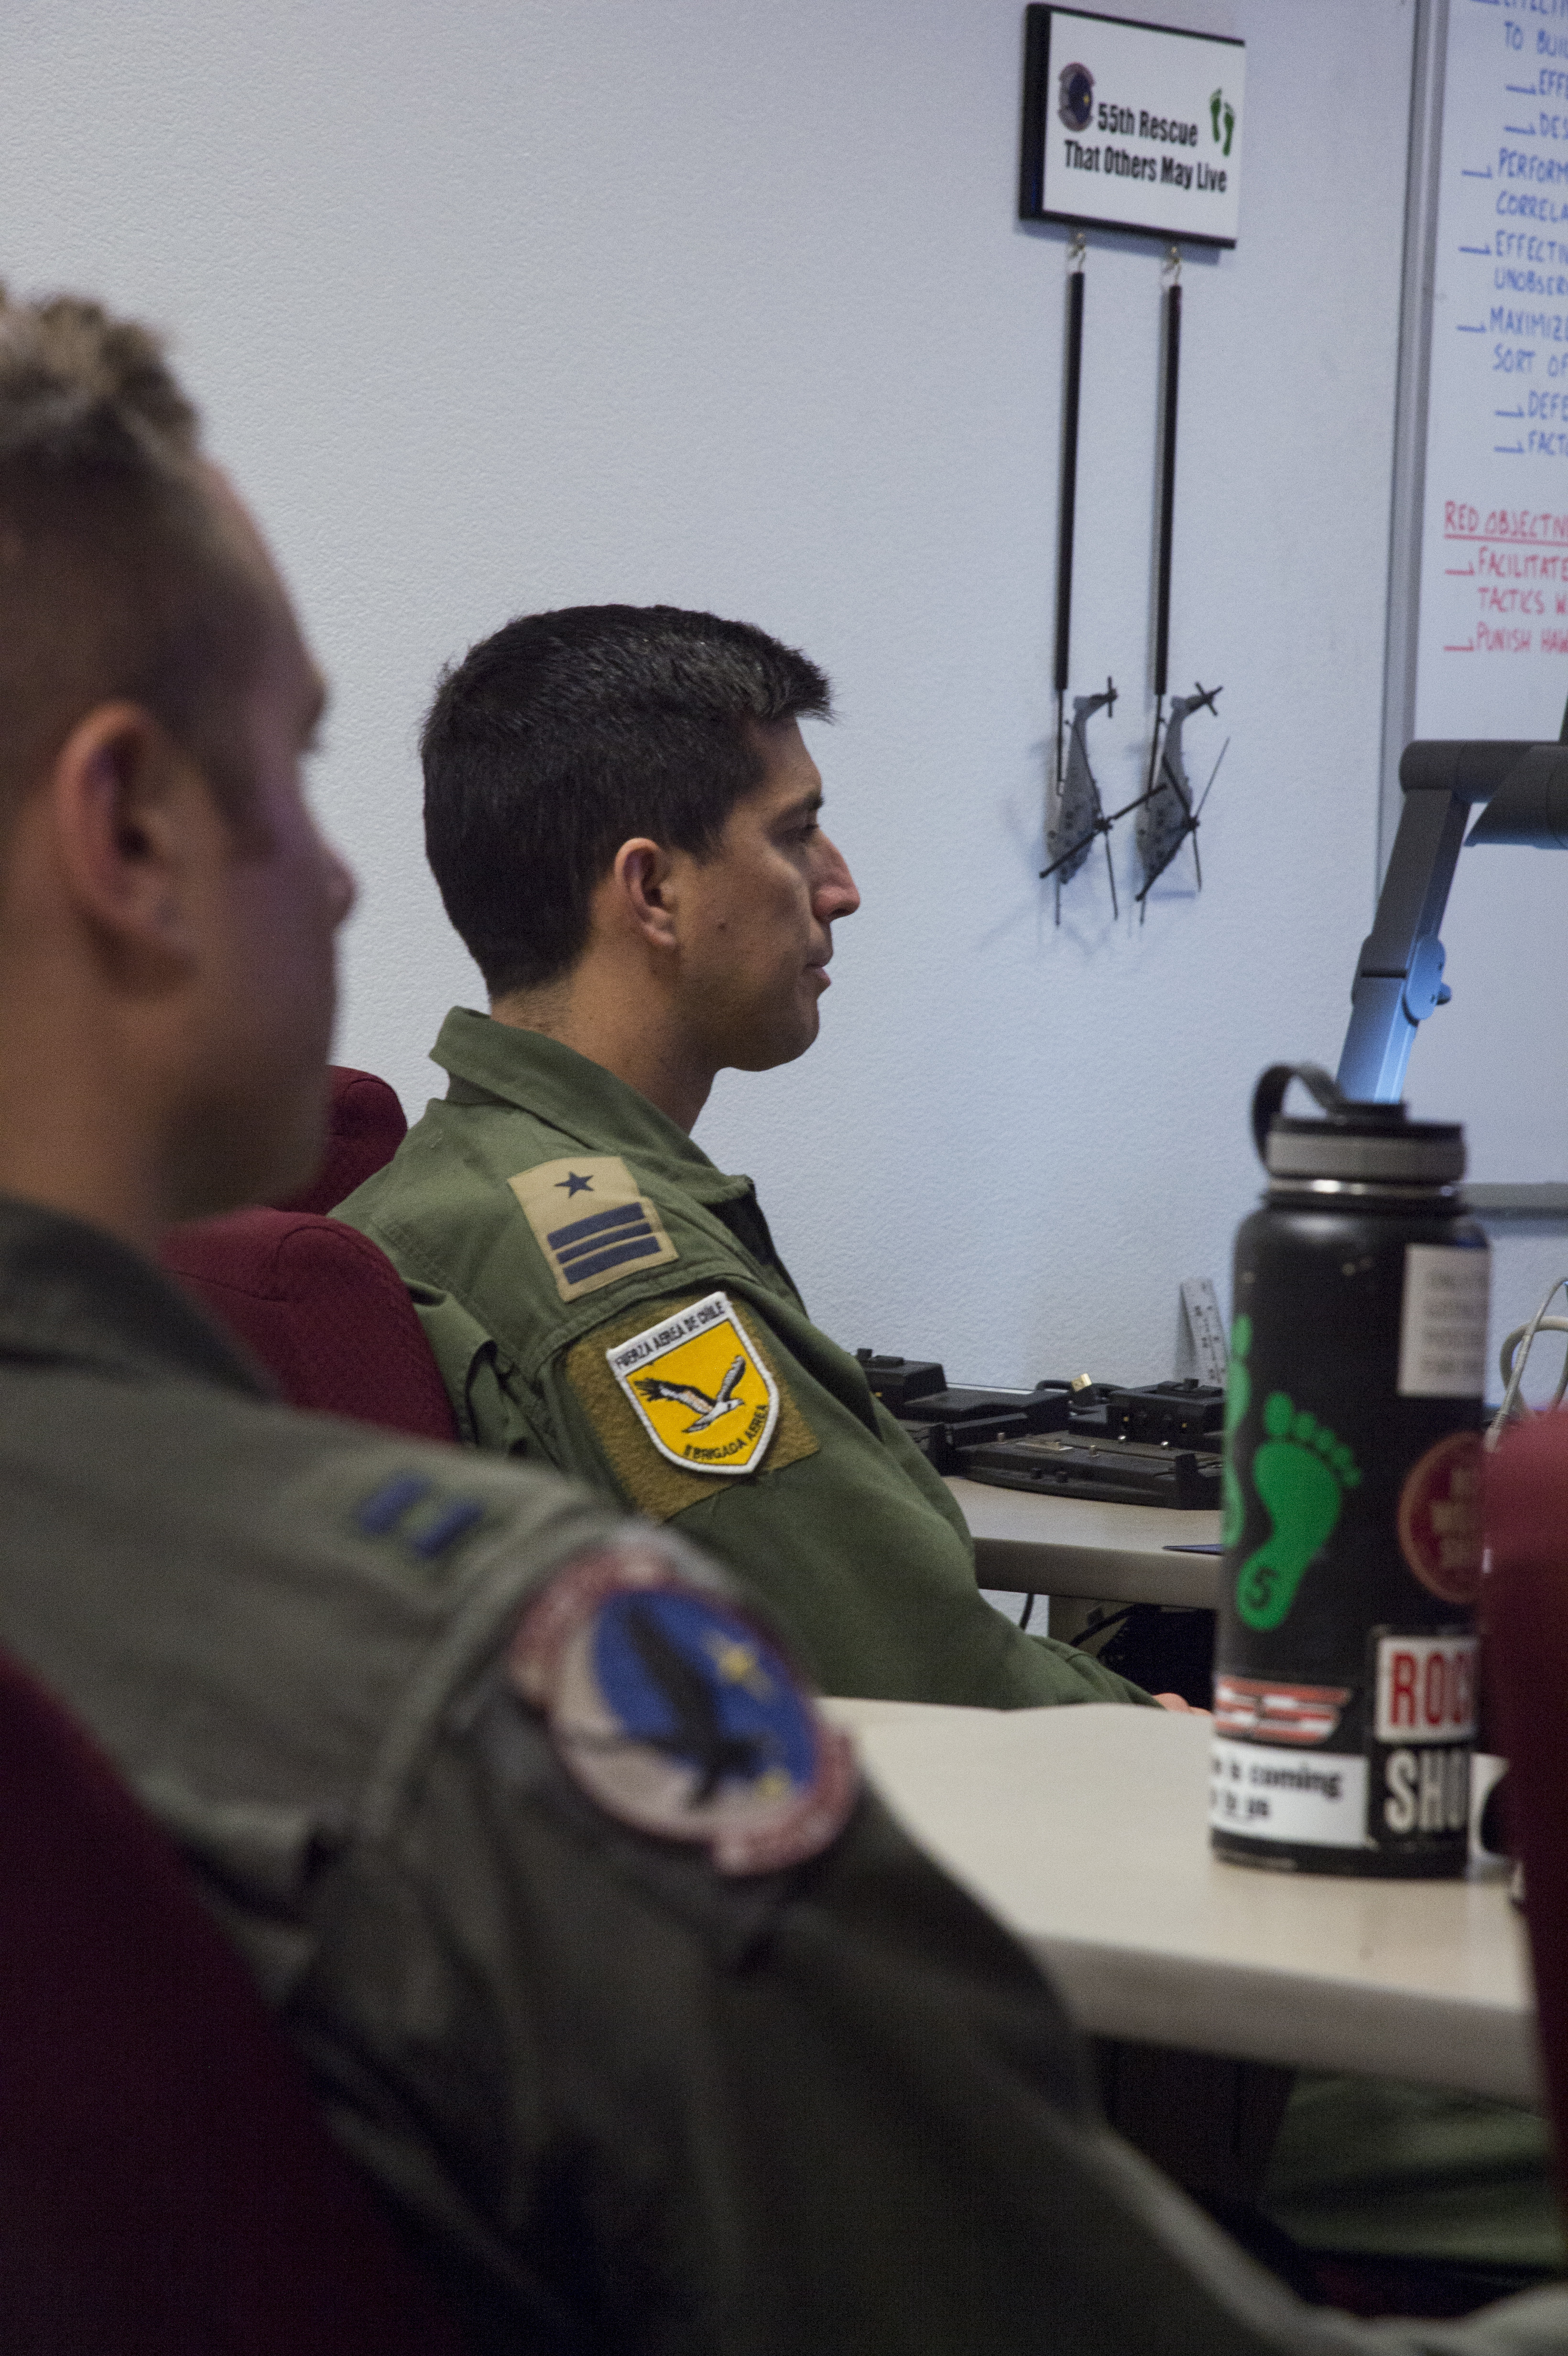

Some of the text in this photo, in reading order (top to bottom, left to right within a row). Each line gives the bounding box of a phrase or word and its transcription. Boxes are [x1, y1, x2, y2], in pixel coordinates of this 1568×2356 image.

[1504, 21, 1524, 51] TO
[1099, 102, 1198, 147] 55th Rescue
[1065, 139, 1227, 193] That Others May Live
[1493, 343, 1535, 373] SORT
[1445, 501, 1480, 534] RED
[1476, 621, 1532, 652] PUNISH
[615, 1300, 726, 1370] FUERZA AEREA DE CHILE
[693, 1438, 748, 1460] BRIGADA
[744, 1404, 769, 1442] AEREA
